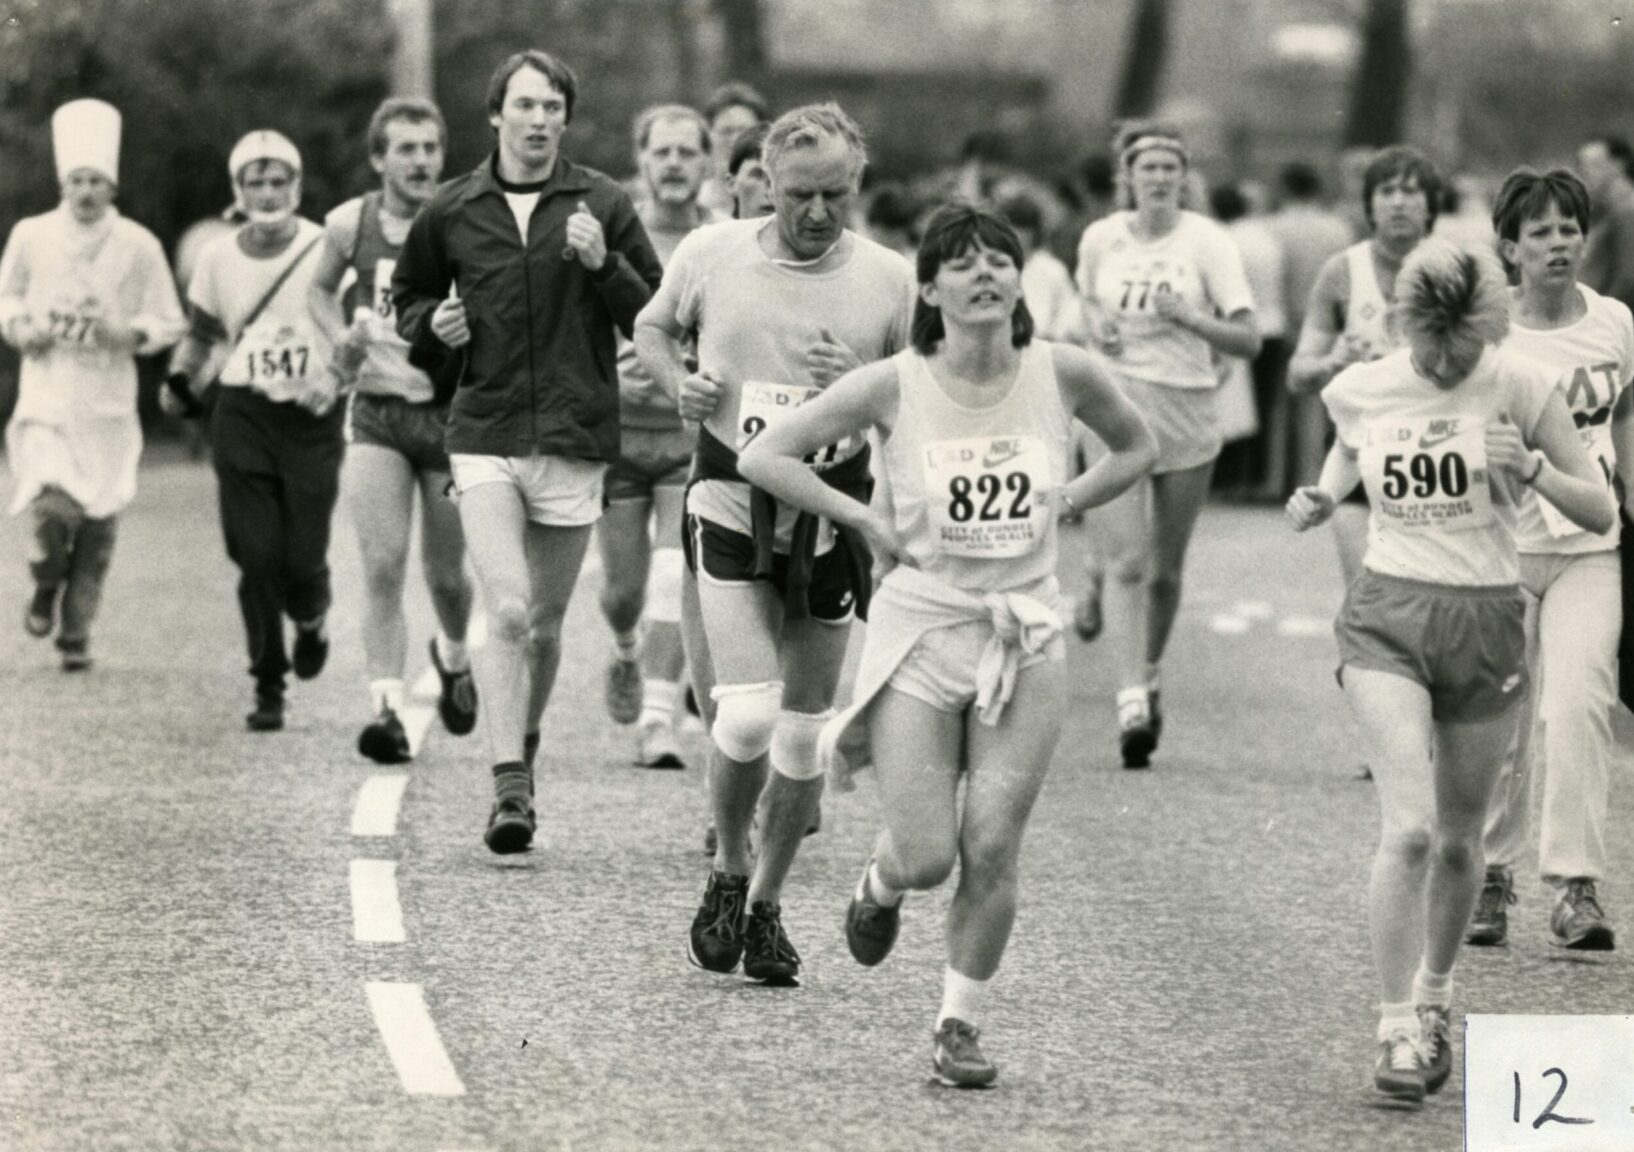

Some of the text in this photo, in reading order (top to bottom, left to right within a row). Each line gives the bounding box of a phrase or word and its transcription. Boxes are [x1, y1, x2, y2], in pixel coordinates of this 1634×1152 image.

[248, 346, 309, 379] 1547
[948, 471, 1031, 523] 822
[1382, 452, 1468, 500] 590
[1513, 1067, 1596, 1130] 12
